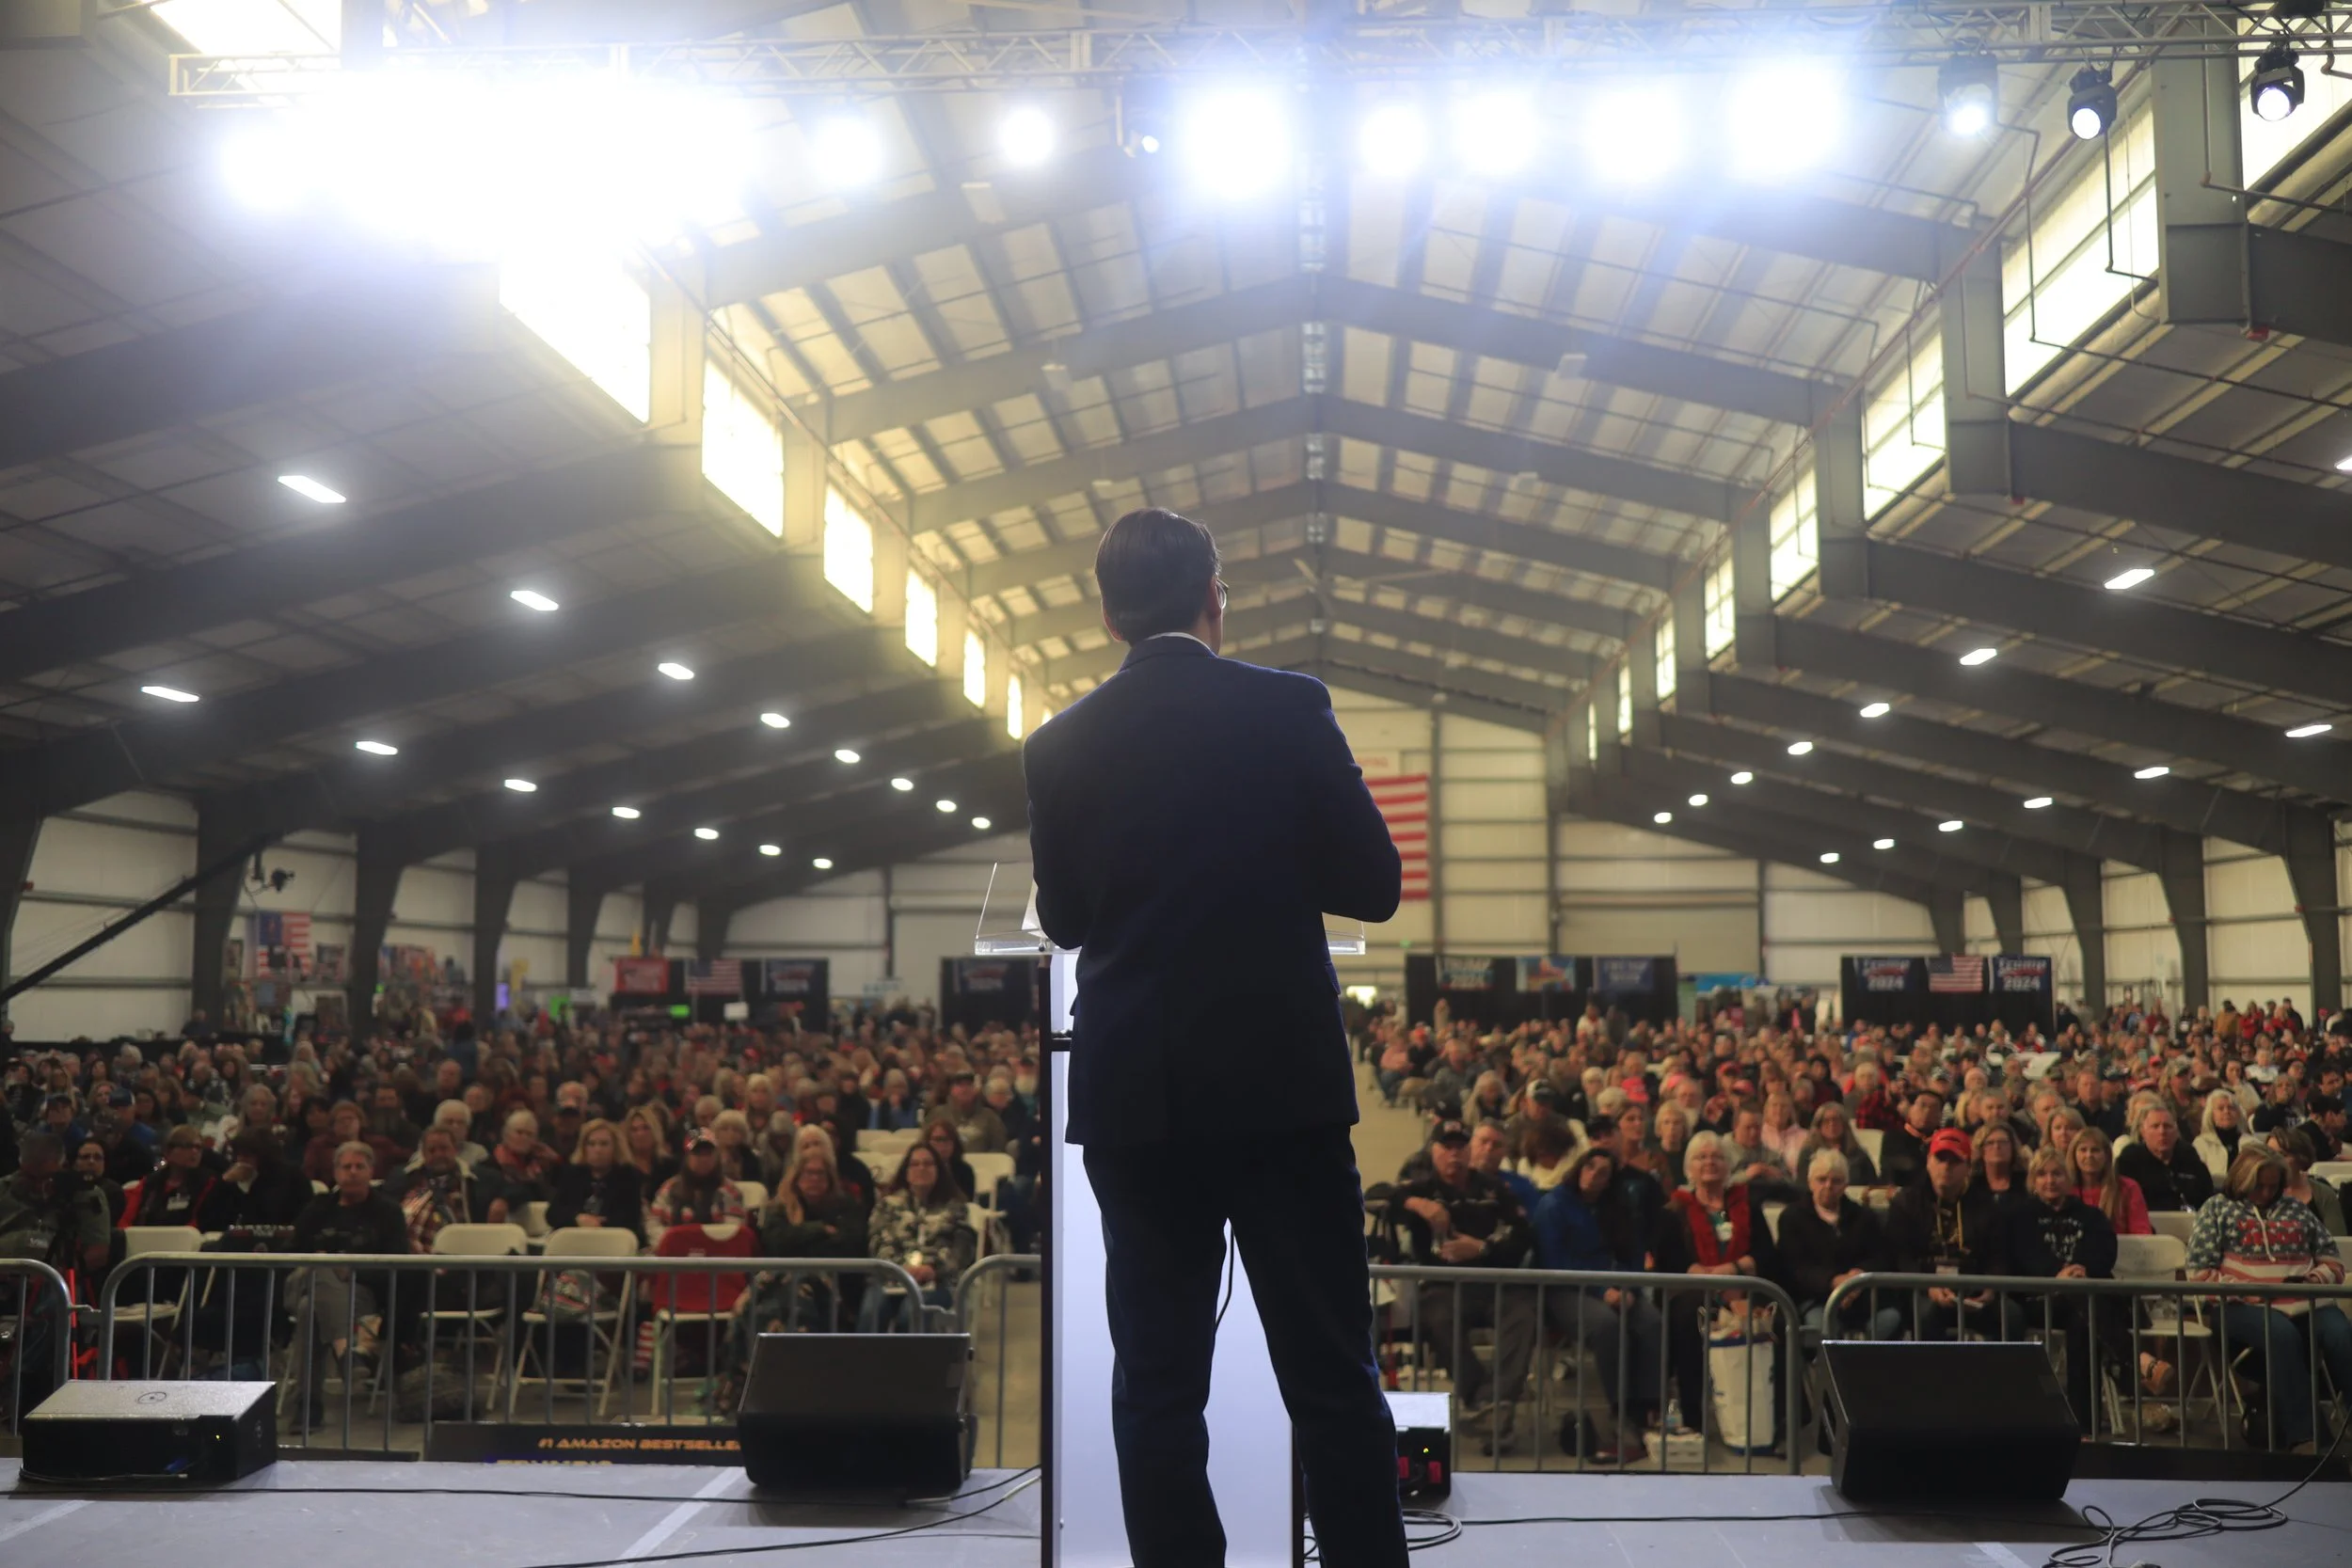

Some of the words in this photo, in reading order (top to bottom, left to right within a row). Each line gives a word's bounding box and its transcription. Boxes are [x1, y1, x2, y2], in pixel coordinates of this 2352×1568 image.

[2003, 975, 2041, 992] 2024
[537, 1437, 554, 1449] #1
[556, 1437, 637, 1449] AMAZON
